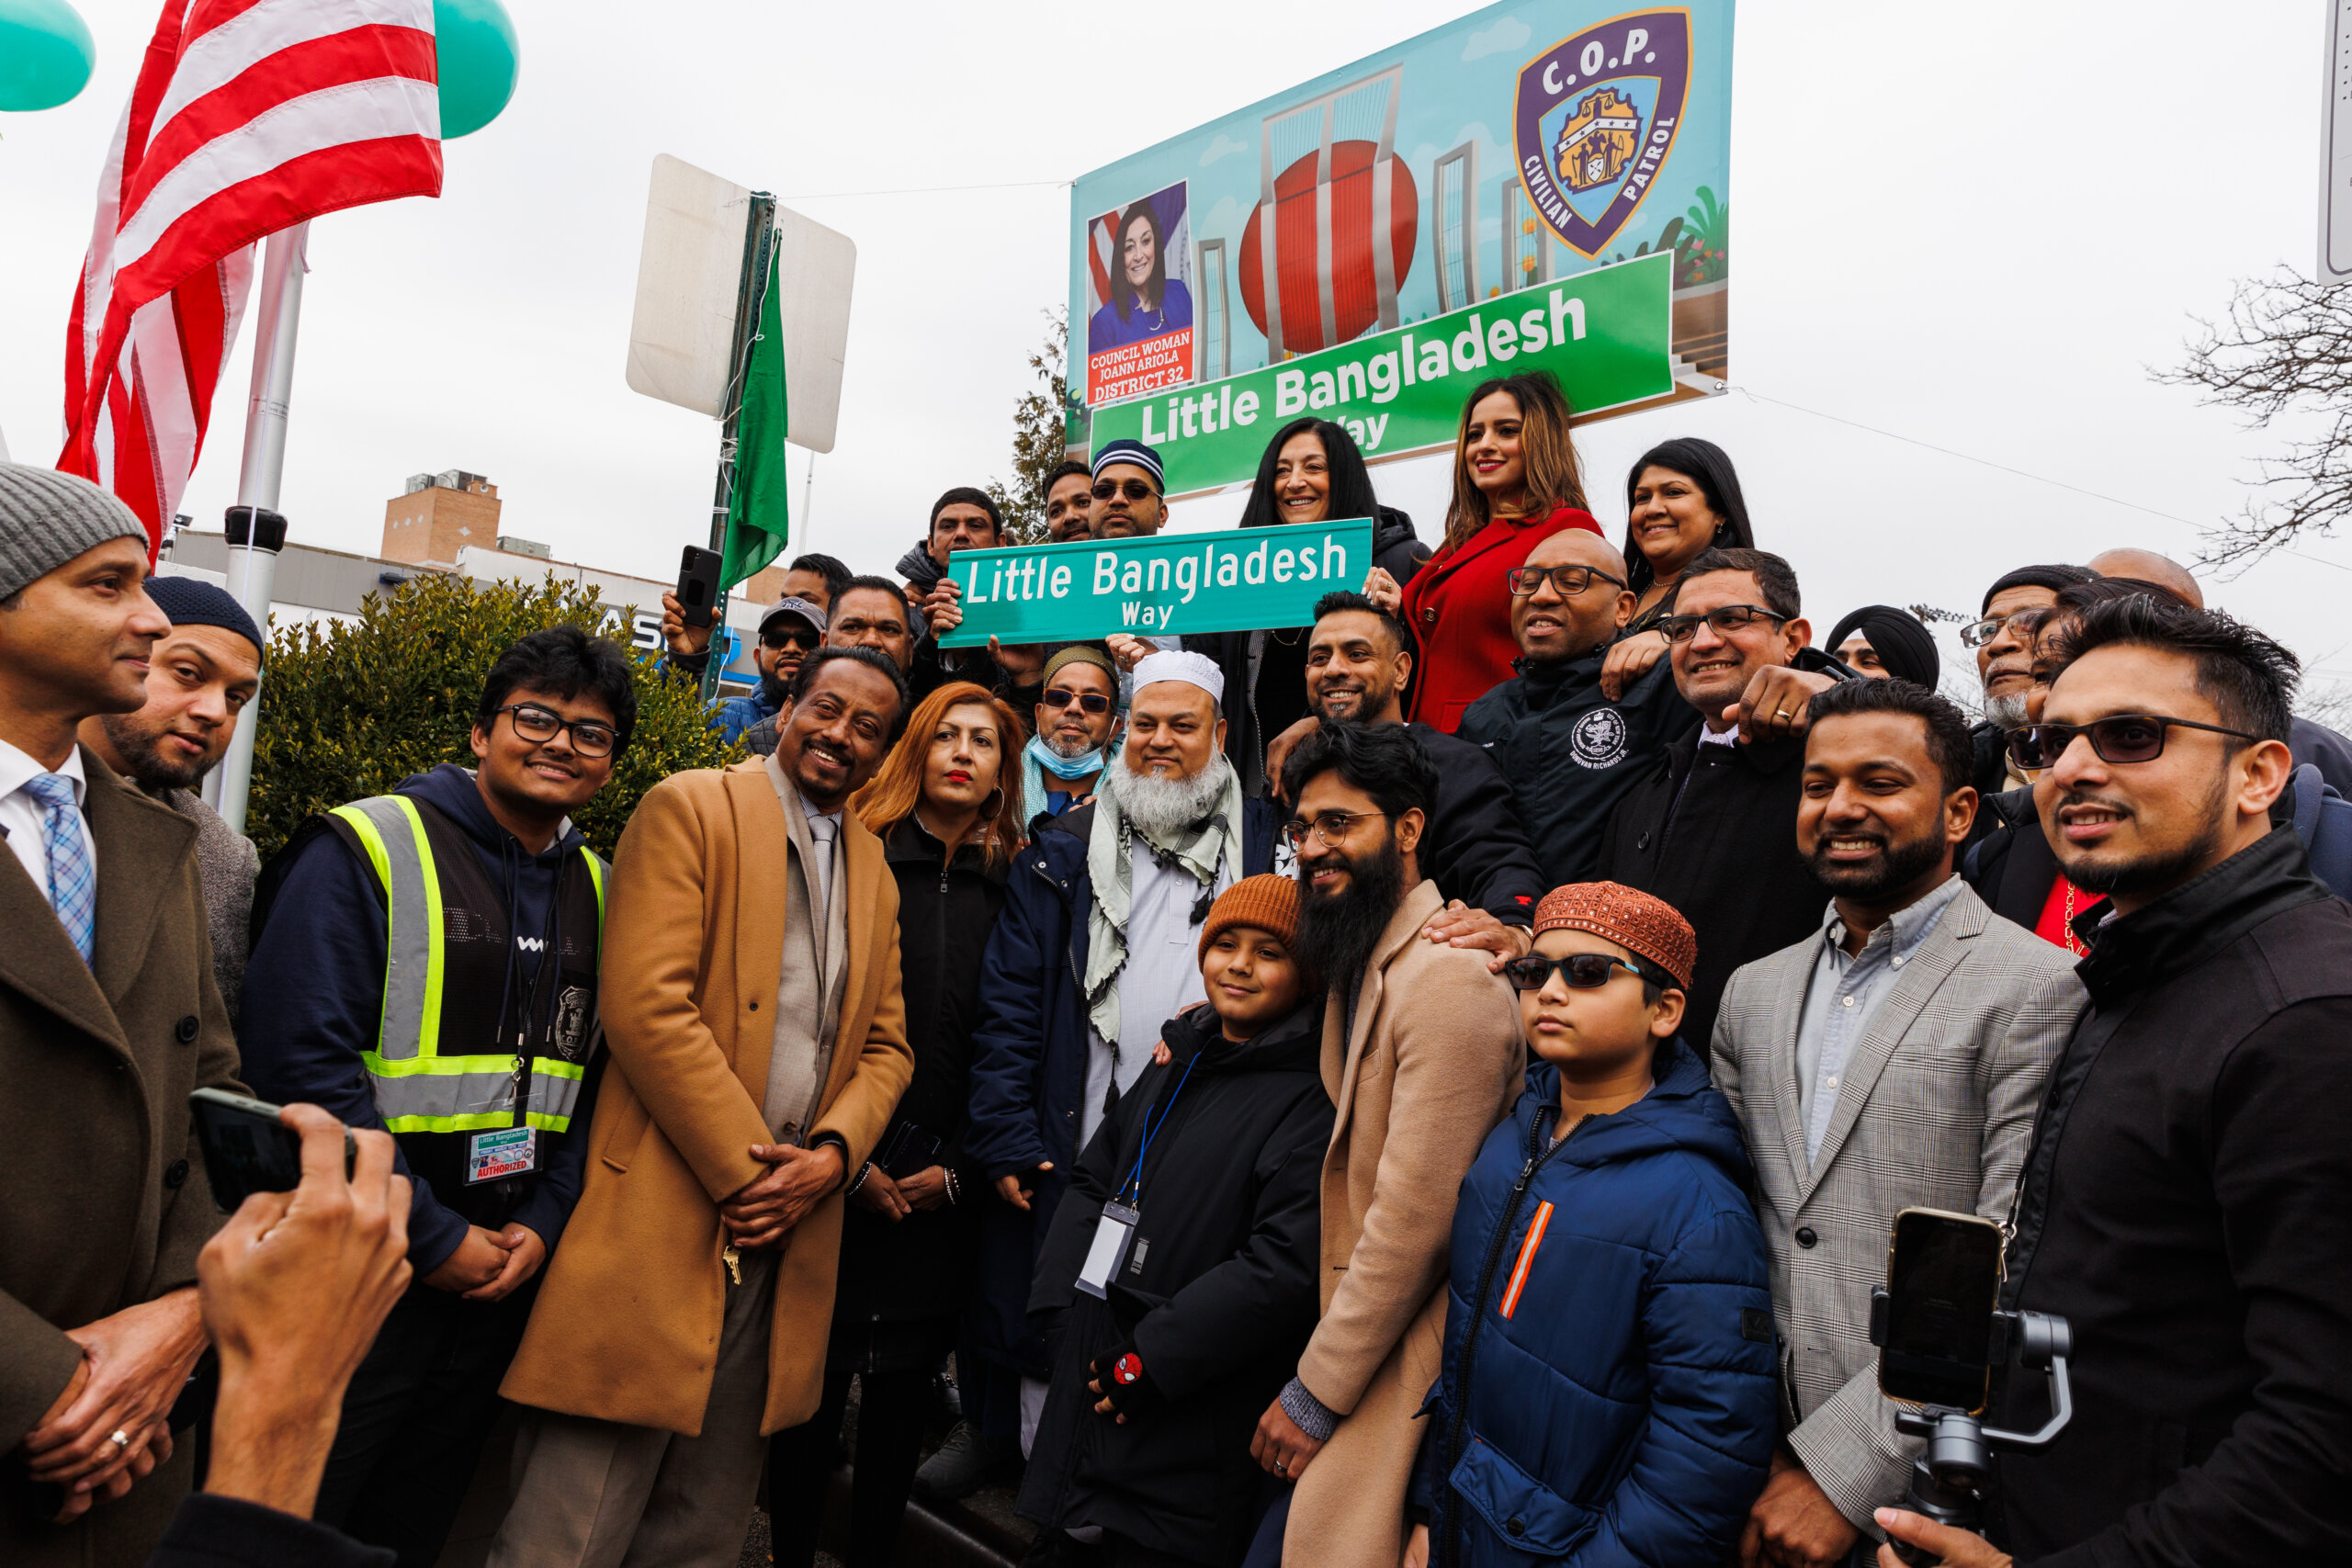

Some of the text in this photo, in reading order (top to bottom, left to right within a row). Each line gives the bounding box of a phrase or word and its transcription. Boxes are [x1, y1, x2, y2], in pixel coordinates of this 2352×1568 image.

[1543, 28, 1656, 95] C.O.P.
[1623, 118, 1675, 201] PATROL
[1524, 155, 1572, 229] CIVILIAN
[1091, 332, 1190, 369] COUNCIL WOMAN
[1101, 350, 1179, 382] JOANN ARIOLA
[1141, 289, 1587, 446] Little Bangladesh
[1095, 367, 1184, 401] DISTRICT 32
[967, 534, 1346, 604] Little Bangladesh
[1122, 601, 1174, 630] Way
[1570, 750, 1592, 769] DONOVAN
[1593, 754, 1622, 769] RICHARDS
[477, 1160, 526, 1178] AUTHORIZED
